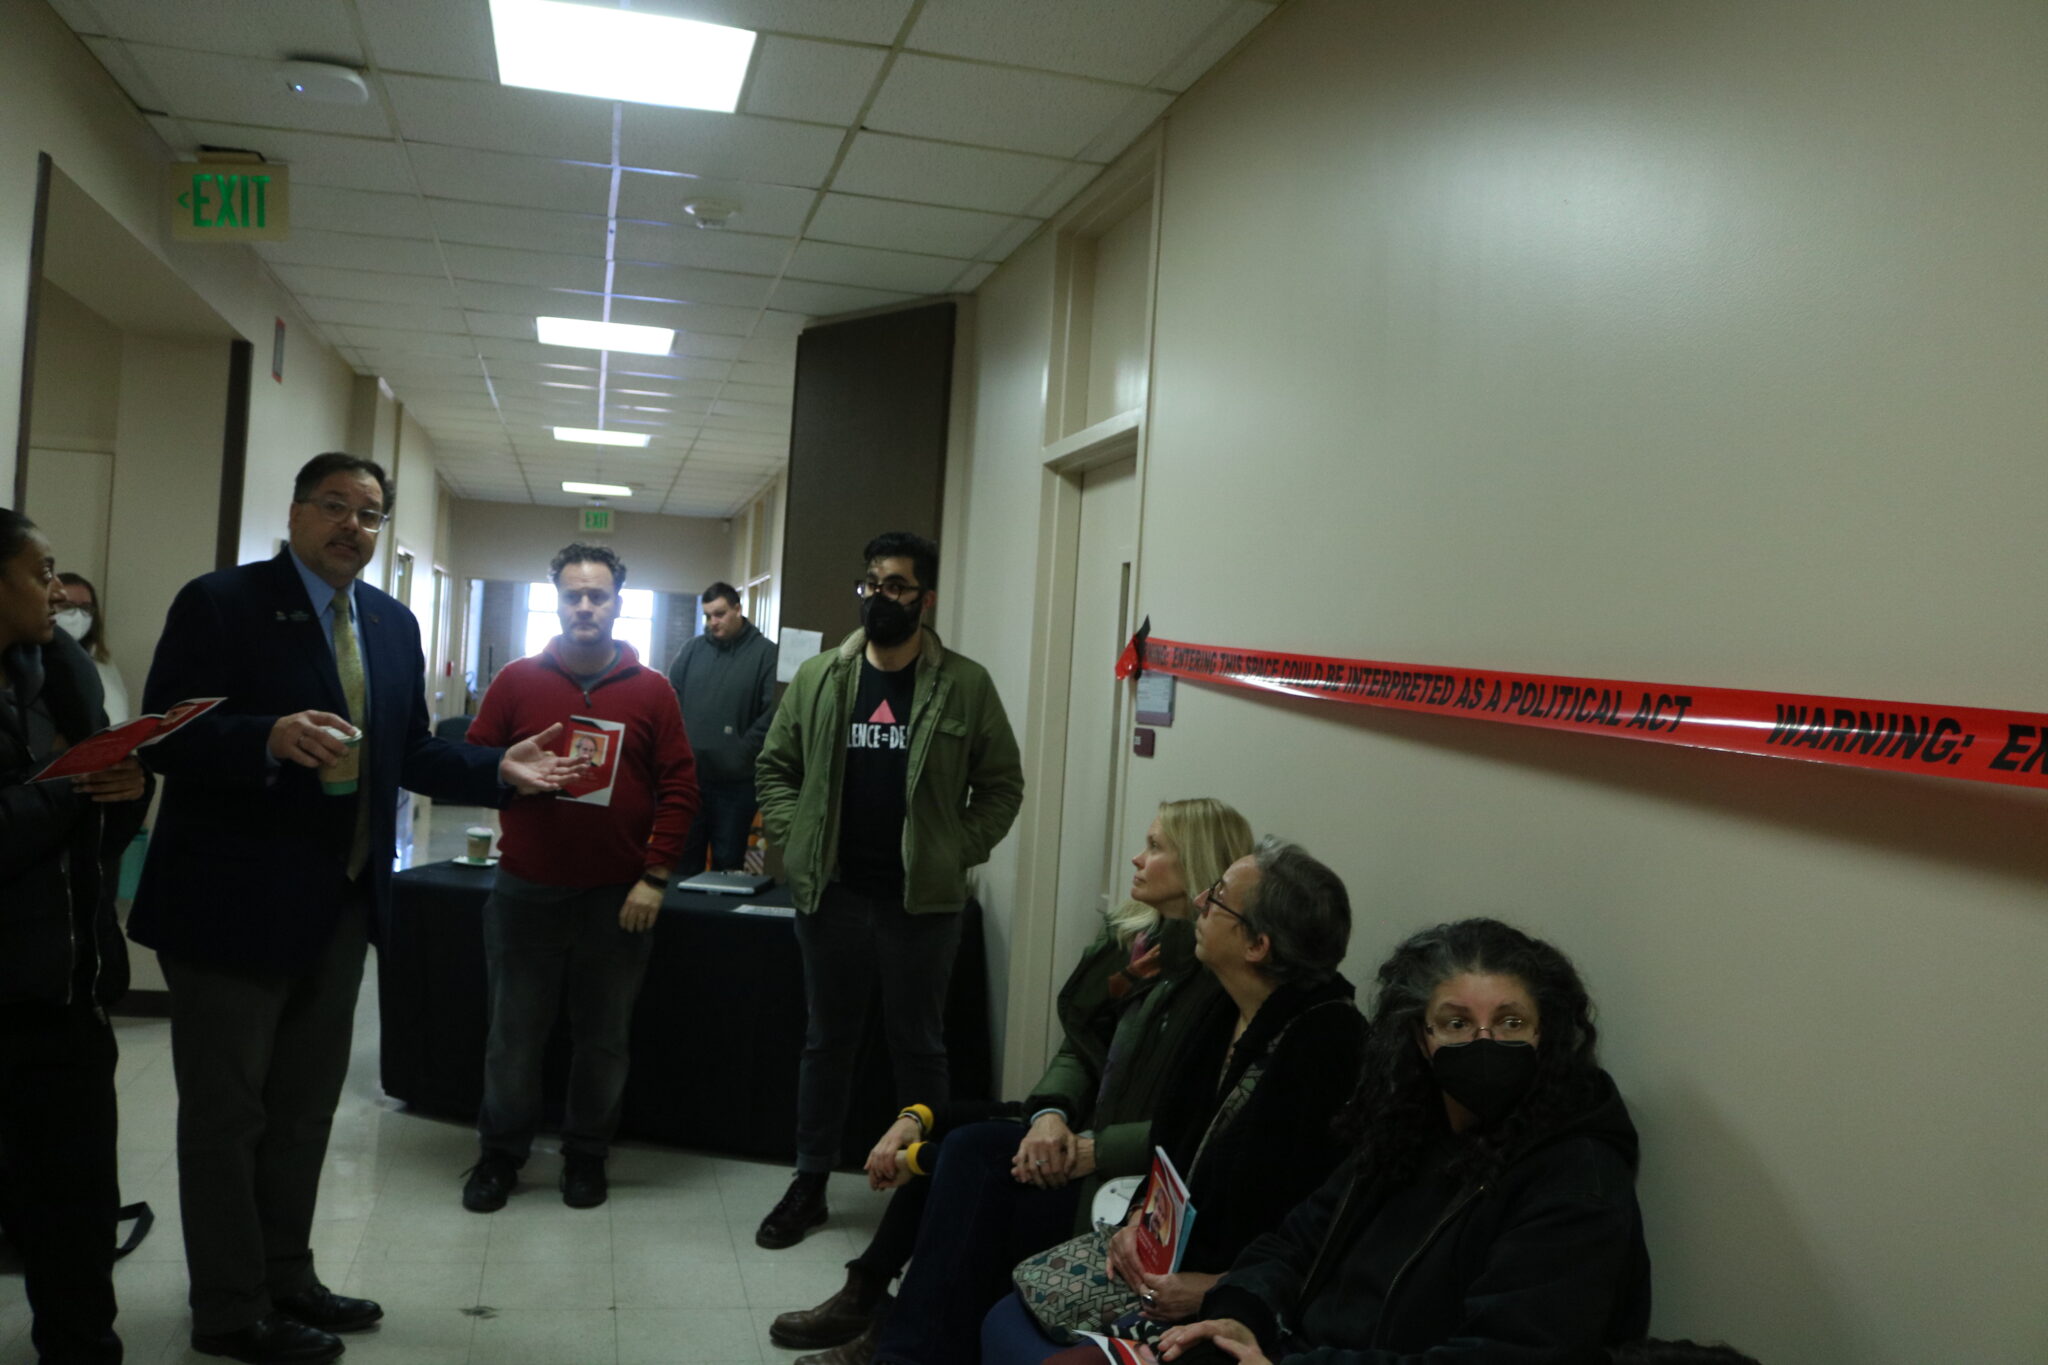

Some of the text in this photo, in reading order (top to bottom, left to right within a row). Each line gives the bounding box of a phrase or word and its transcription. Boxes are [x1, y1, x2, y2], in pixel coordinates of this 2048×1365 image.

[193, 174, 270, 227] EXIT
[585, 511, 609, 529] EXIT
[1172, 647, 1218, 674] ENTERING
[1218, 653, 1242, 677] THIS
[1245, 656, 1280, 682] SPACE
[1278, 660, 1324, 689] COULD
[1322, 664, 1345, 692] BE
[1343, 666, 1456, 706] INTERPRETED
[1453, 677, 1485, 710] AS
[1481, 680, 1502, 712] A
[1502, 681, 1622, 726] POLITICAL
[1626, 692, 1693, 733] ACT
[1766, 703, 1976, 765] WARNING:
